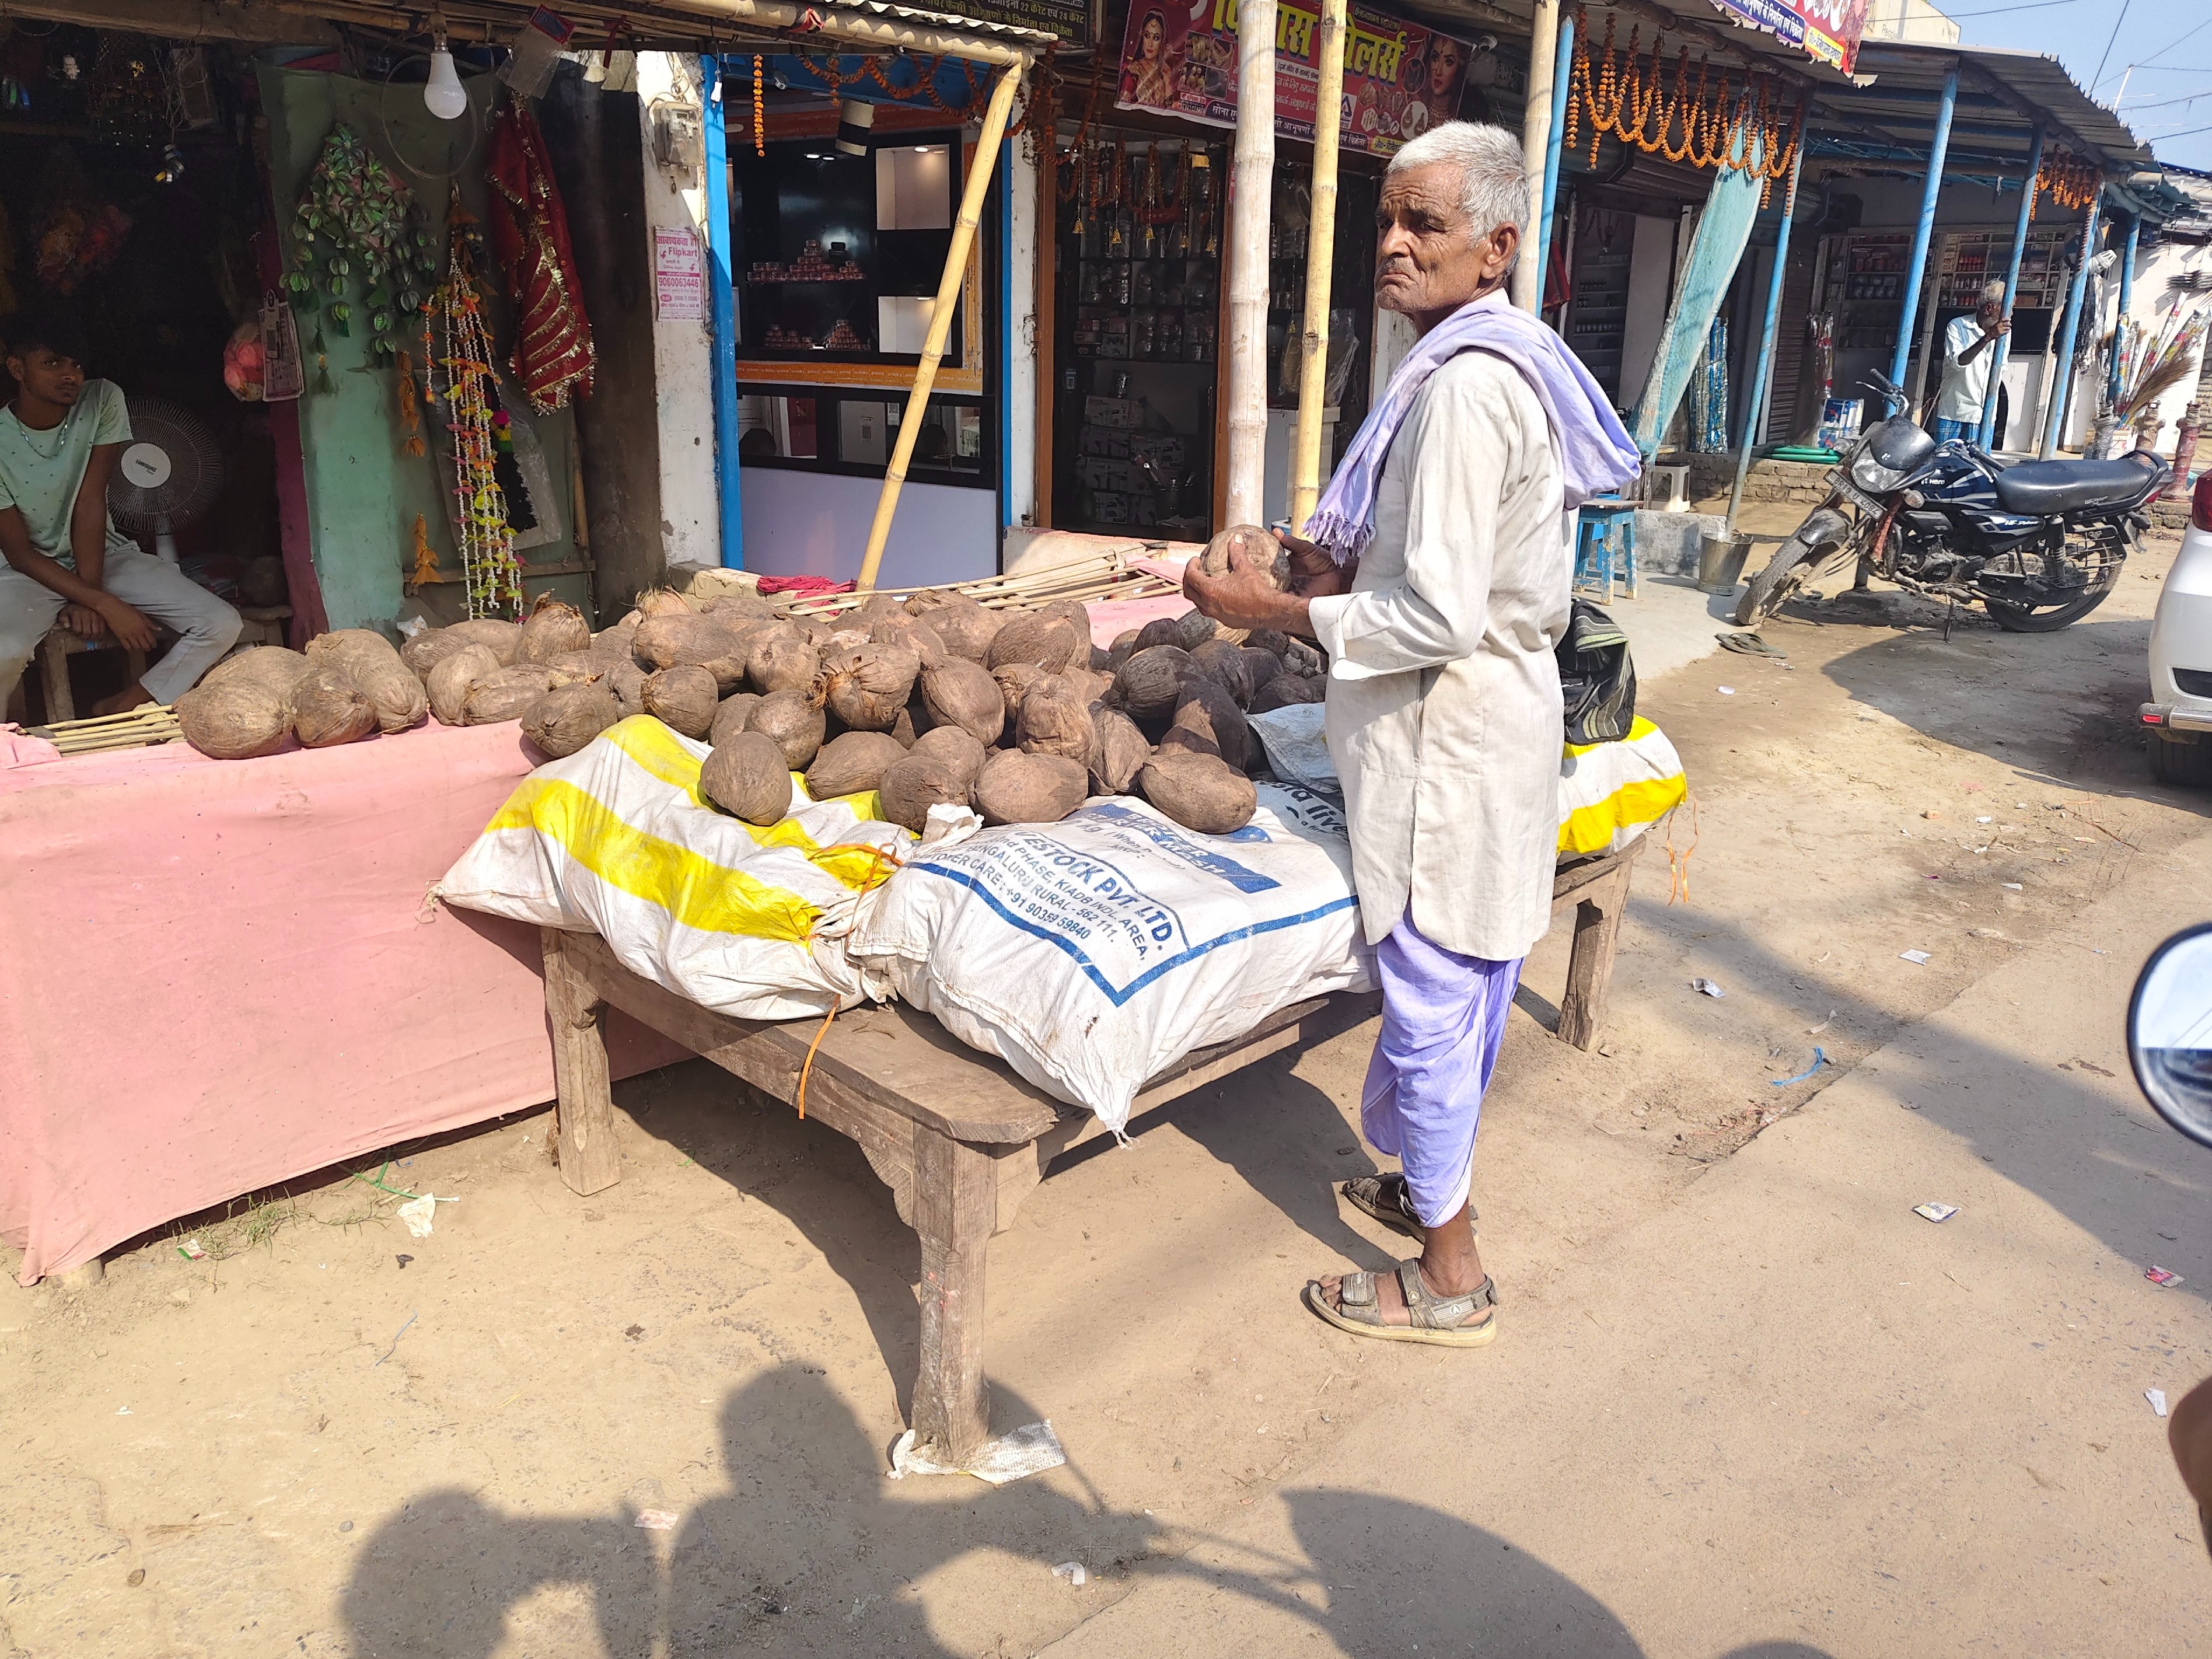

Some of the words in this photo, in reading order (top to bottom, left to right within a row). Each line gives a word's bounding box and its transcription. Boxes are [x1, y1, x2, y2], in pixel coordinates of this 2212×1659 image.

[656, 236, 689, 246] आवश्यकता
[668, 247, 698, 258] Flipkart
[658, 277, 699, 288] 9060063446
[966, 844, 1034, 888] BENGALURU
[1030, 883, 1072, 911] RURAL
[1075, 907, 1099, 921] 562
[1015, 847, 1055, 883] PHASE,
[1054, 879, 1095, 904] KIADB
[1118, 919, 1149, 961] AREA,
[1025, 903, 1059, 924] 90359
[1056, 916, 1091, 939] 59840
[1093, 877, 1141, 909] PVT.
[1134, 906, 1173, 951] LTD.
